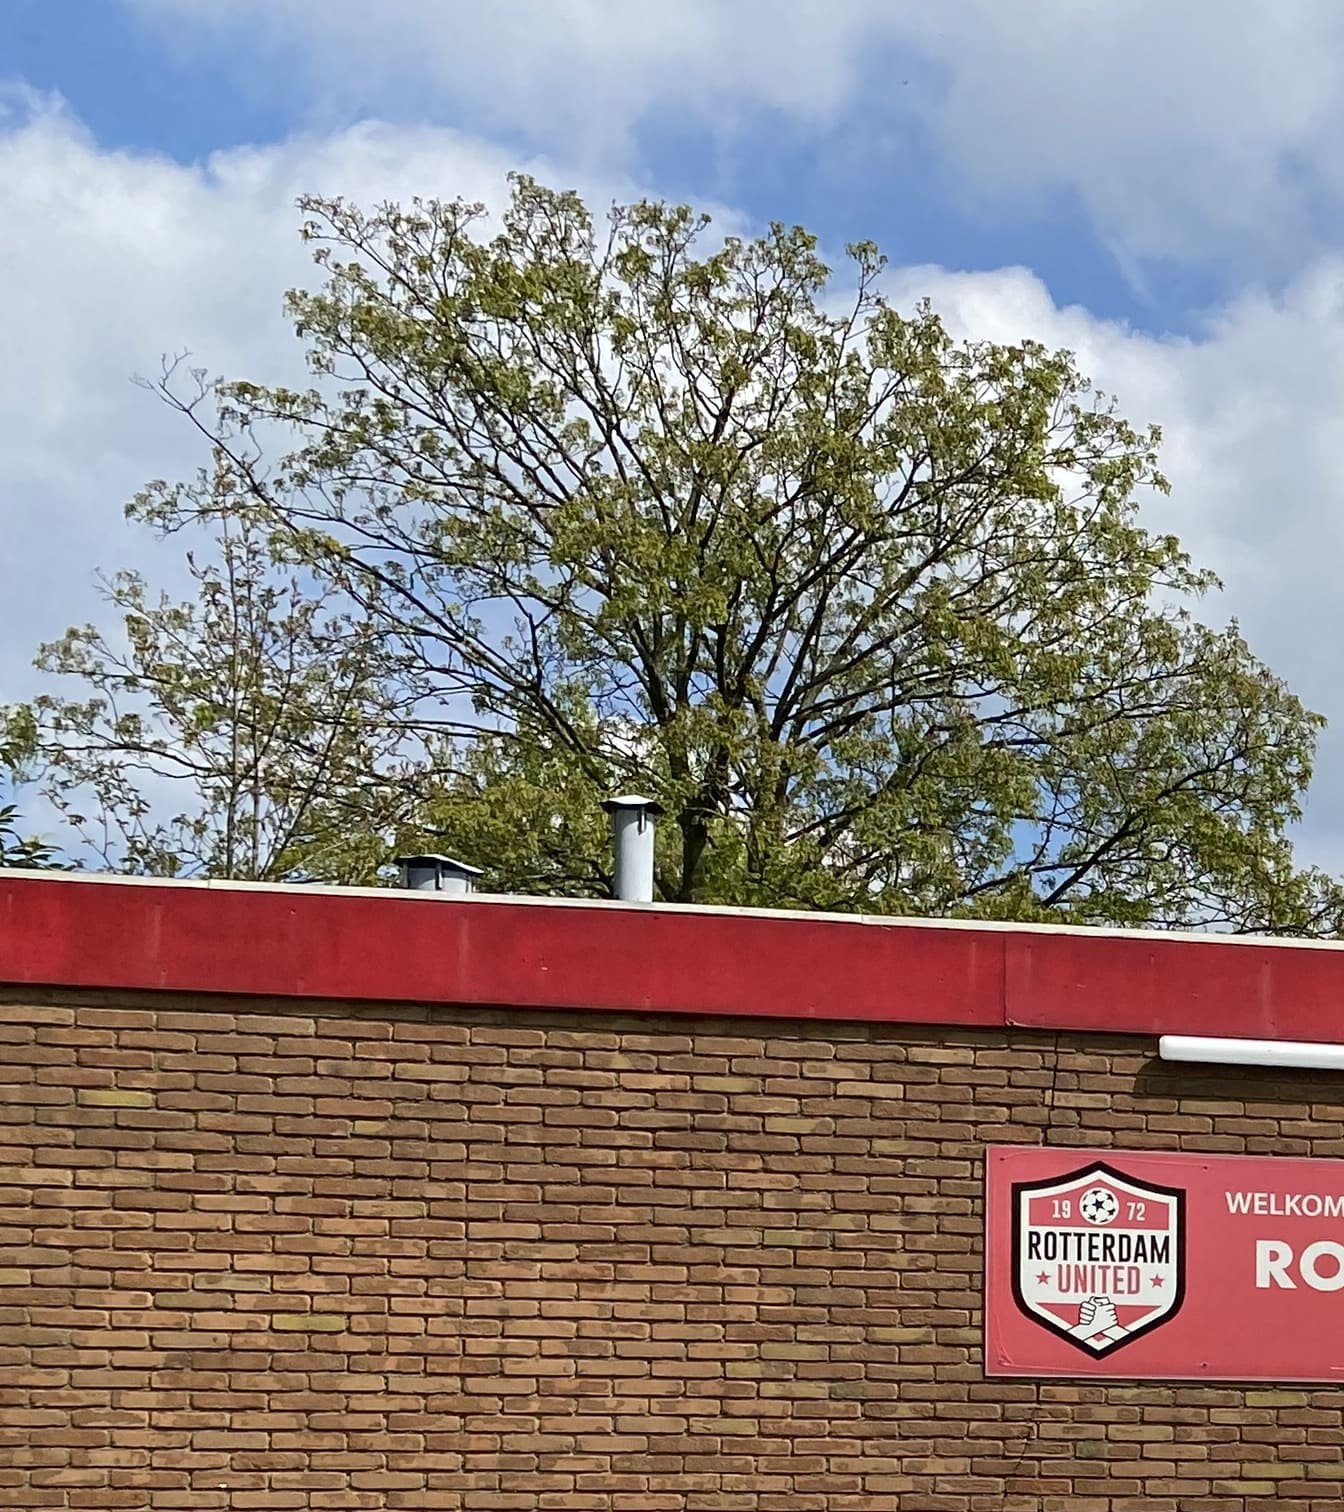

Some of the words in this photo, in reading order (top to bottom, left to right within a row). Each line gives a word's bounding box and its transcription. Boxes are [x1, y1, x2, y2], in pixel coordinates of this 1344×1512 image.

[1052, 1199, 1071, 1218] 19
[1126, 1202, 1146, 1221] 72
[1027, 1230, 1170, 1264] ROTTERDAM
[1057, 1263, 1141, 1295] UNITED
